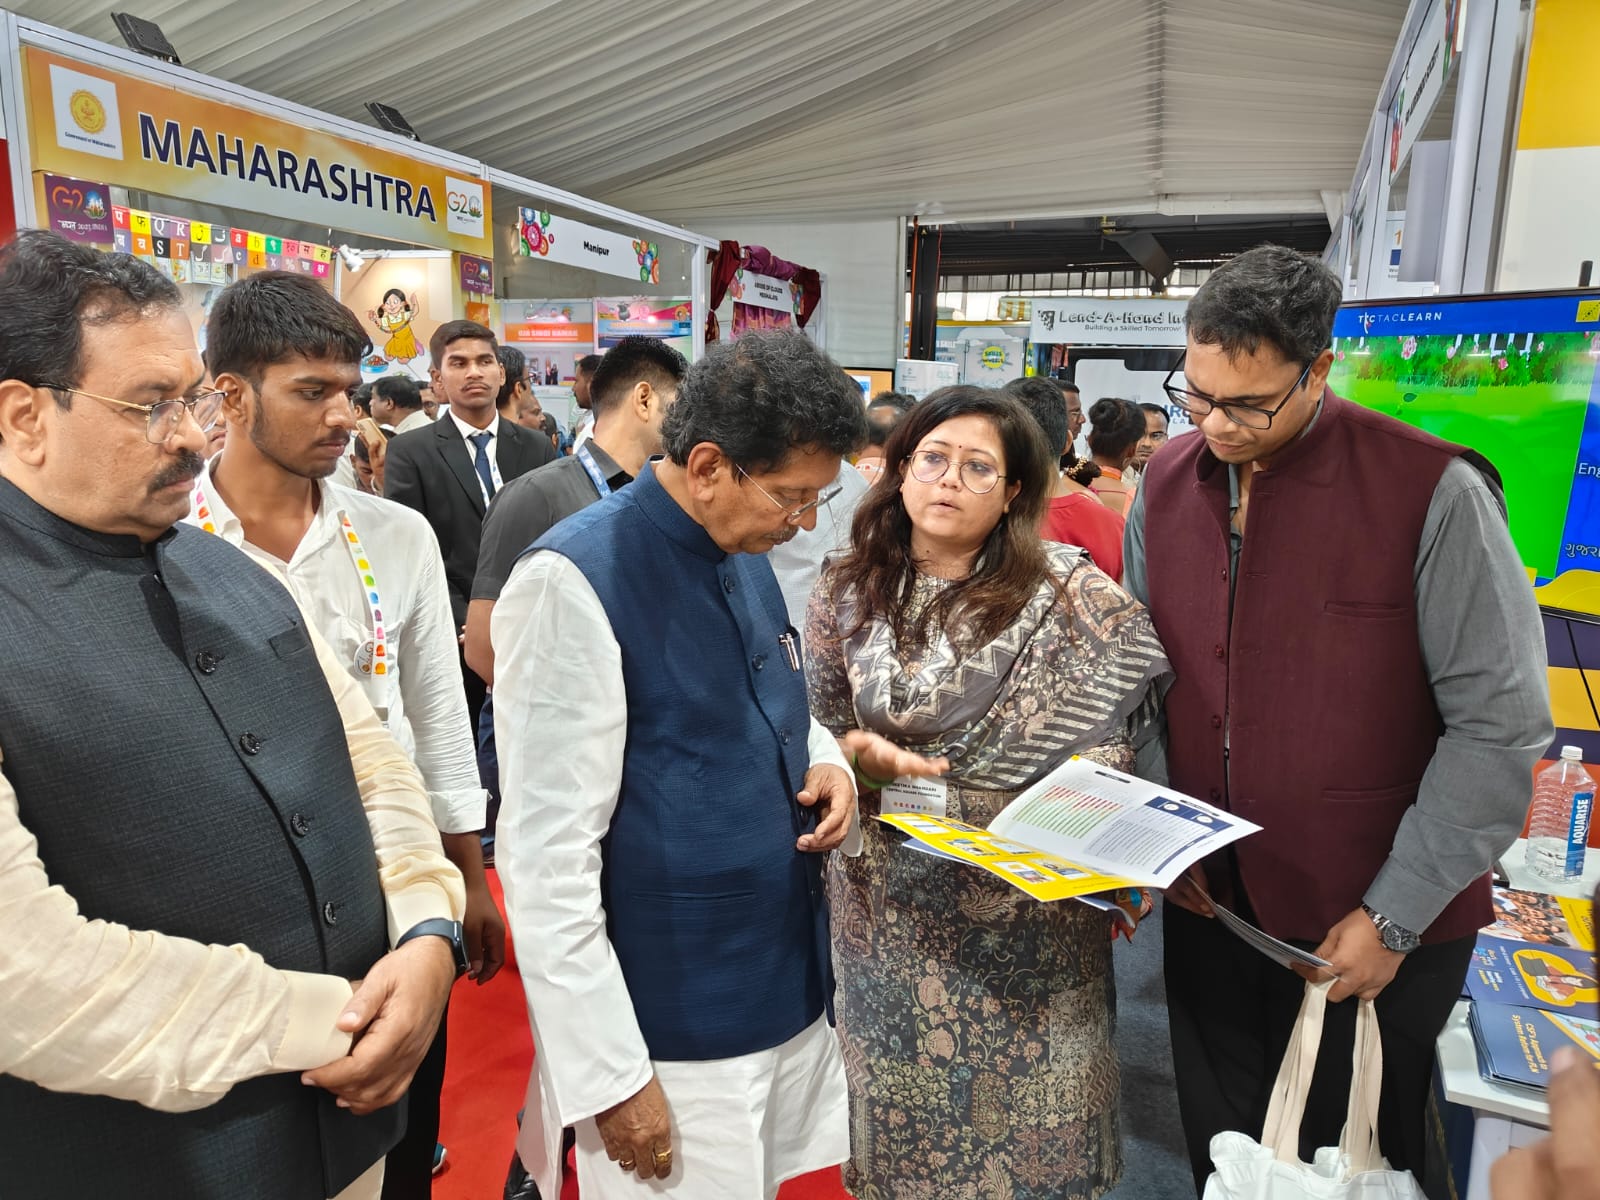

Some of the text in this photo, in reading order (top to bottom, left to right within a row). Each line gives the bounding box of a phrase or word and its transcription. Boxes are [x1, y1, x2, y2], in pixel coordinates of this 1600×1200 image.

[138, 112, 437, 223] MAHARASHTRA
[154, 217, 186, 237] Q R
[157, 240, 185, 257] S T
[583, 240, 610, 257] Manipur
[1084, 324, 1113, 332] Building
[1119, 324, 1143, 332] Skilled
[1572, 799, 1589, 845] AQUARISE
